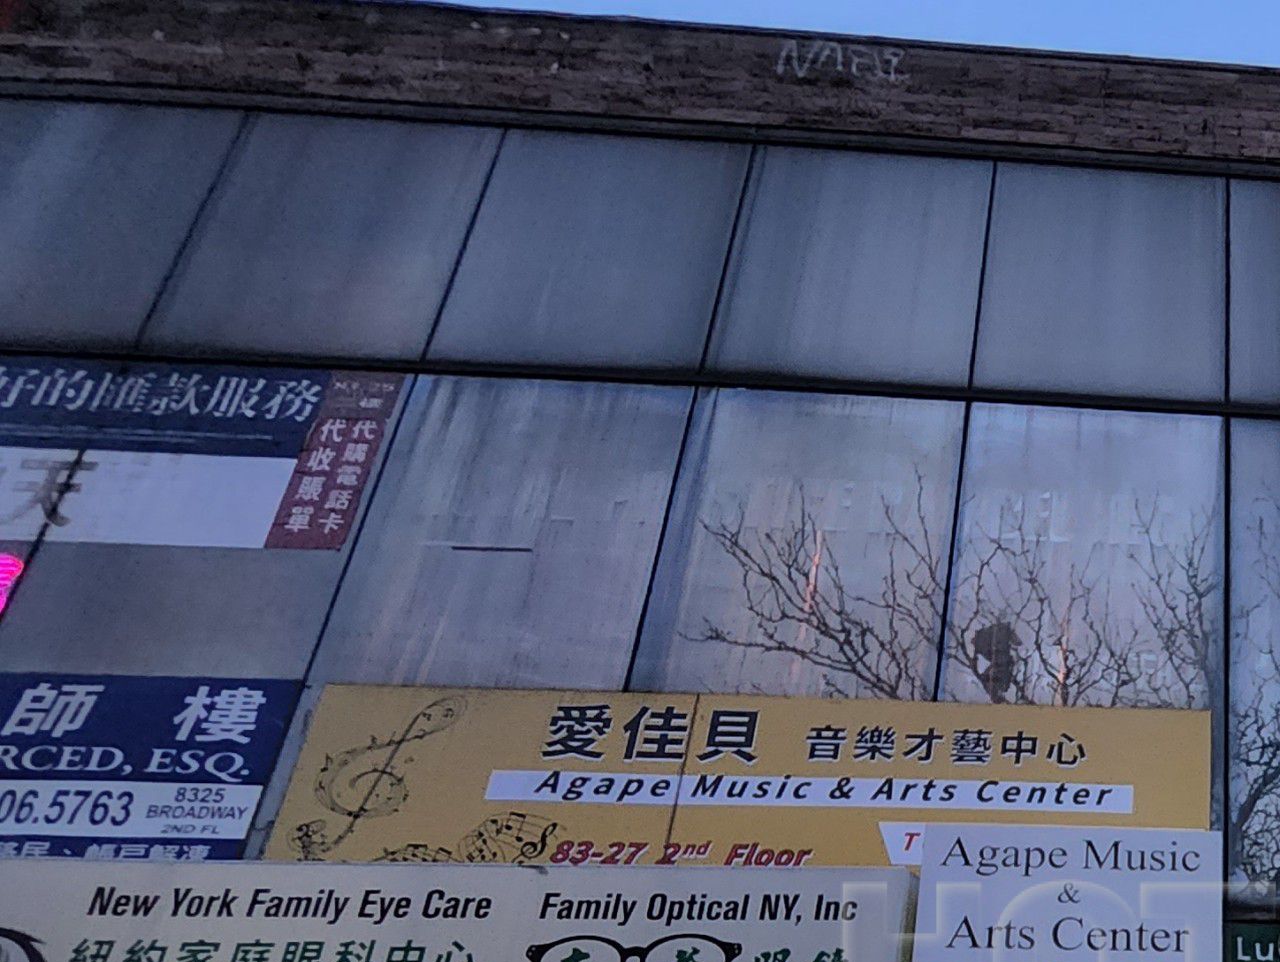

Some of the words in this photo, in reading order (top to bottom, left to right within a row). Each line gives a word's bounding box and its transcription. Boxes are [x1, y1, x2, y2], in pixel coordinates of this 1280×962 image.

[541, 705, 761, 762] 愛佳貝
[805, 725, 1087, 765] 音樂才藝中心
[144, 747, 250, 783] ESQ.
[174, 787, 226, 803] 8325
[534, 770, 672, 802] Agape
[691, 776, 808, 801] Music
[829, 778, 854, 800] &
[871, 778, 957, 802] Arts
[975, 780, 1113, 806] Center
[145, 805, 248, 821] BROADWAY
[550, 841, 648, 865] 83-27
[723, 843, 813, 866] Floor
[939, 836, 1068, 877] Agape
[1083, 840, 1201, 872] Music
[88, 887, 160, 917] New
[170, 889, 238, 918] York
[246, 889, 350, 924] Family
[357, 889, 412, 925] Eye
[421, 892, 492, 920] Care
[538, 893, 637, 927] Family
[646, 893, 750, 926] Optical
[758, 894, 803, 926] NY,
[814, 894, 858, 922] Inc
[1057, 883, 1081, 904] &
[944, 915, 1036, 951] Arts
[1051, 917, 1190, 952] Center
